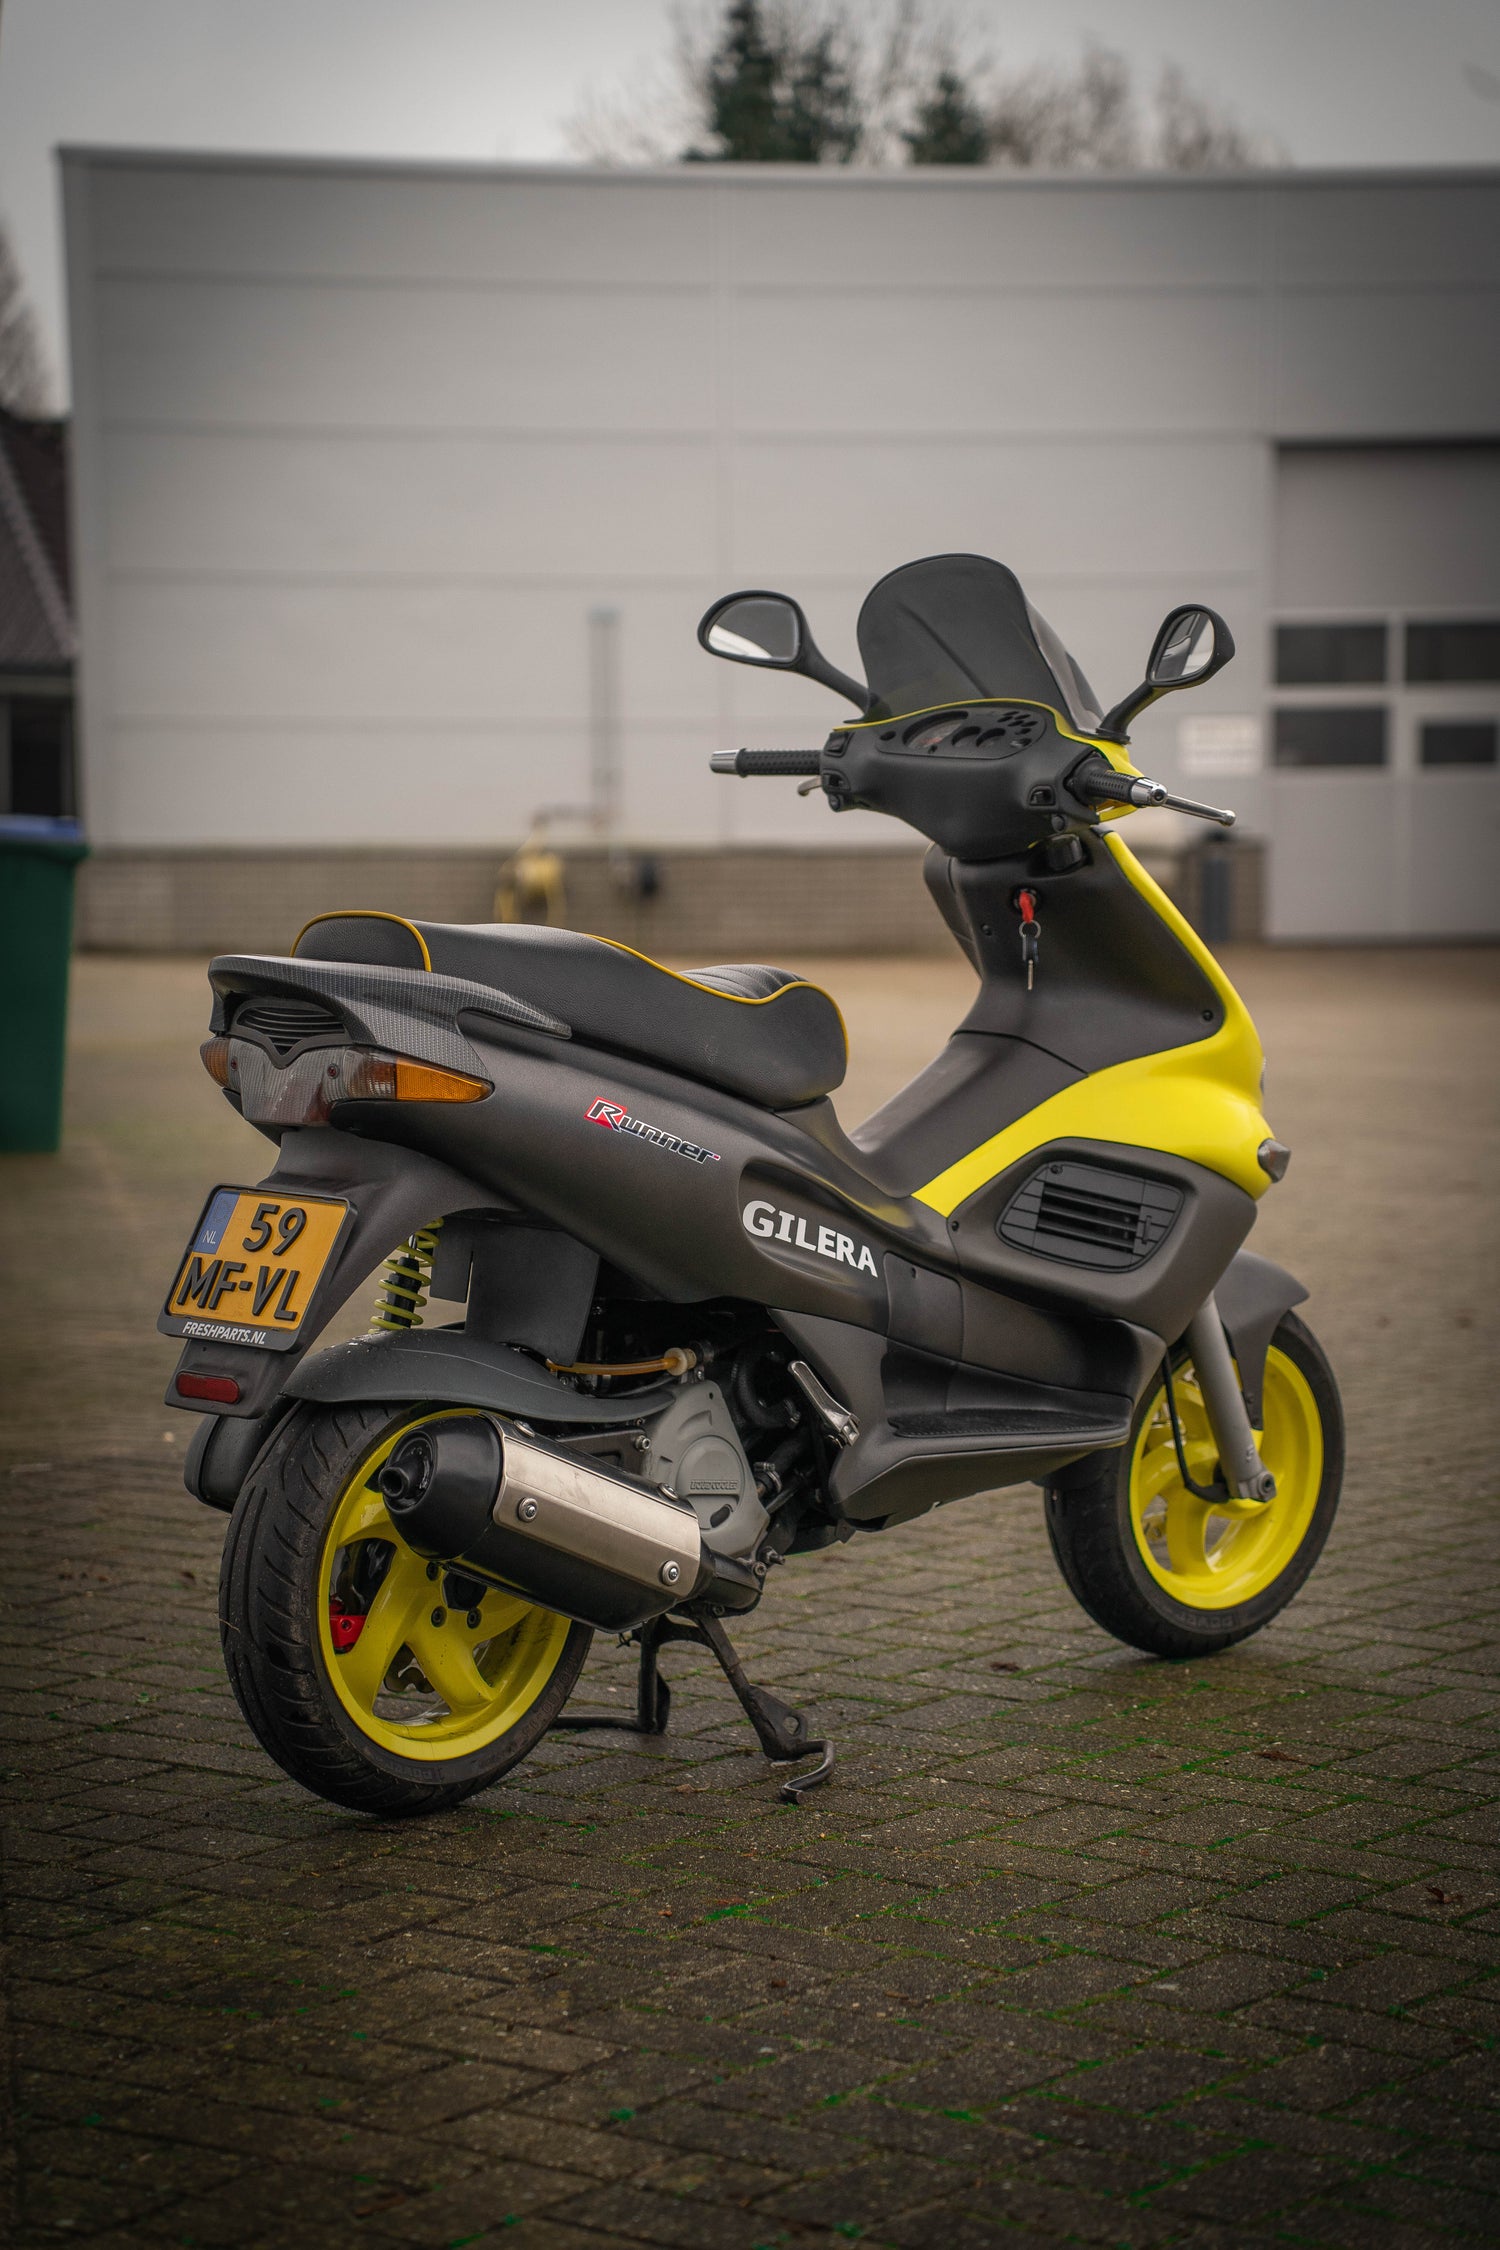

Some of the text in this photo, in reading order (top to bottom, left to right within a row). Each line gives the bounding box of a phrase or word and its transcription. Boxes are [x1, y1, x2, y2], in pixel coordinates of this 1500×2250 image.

[586, 1098, 721, 1165] Runner
[202, 1229, 216, 1245] NL
[242, 1202, 307, 1257] 59
[742, 1200, 878, 1278] GILERA
[176, 1257, 300, 1322] MF-VL
[182, 1321, 267, 1345] FRESHPARTS.NL
